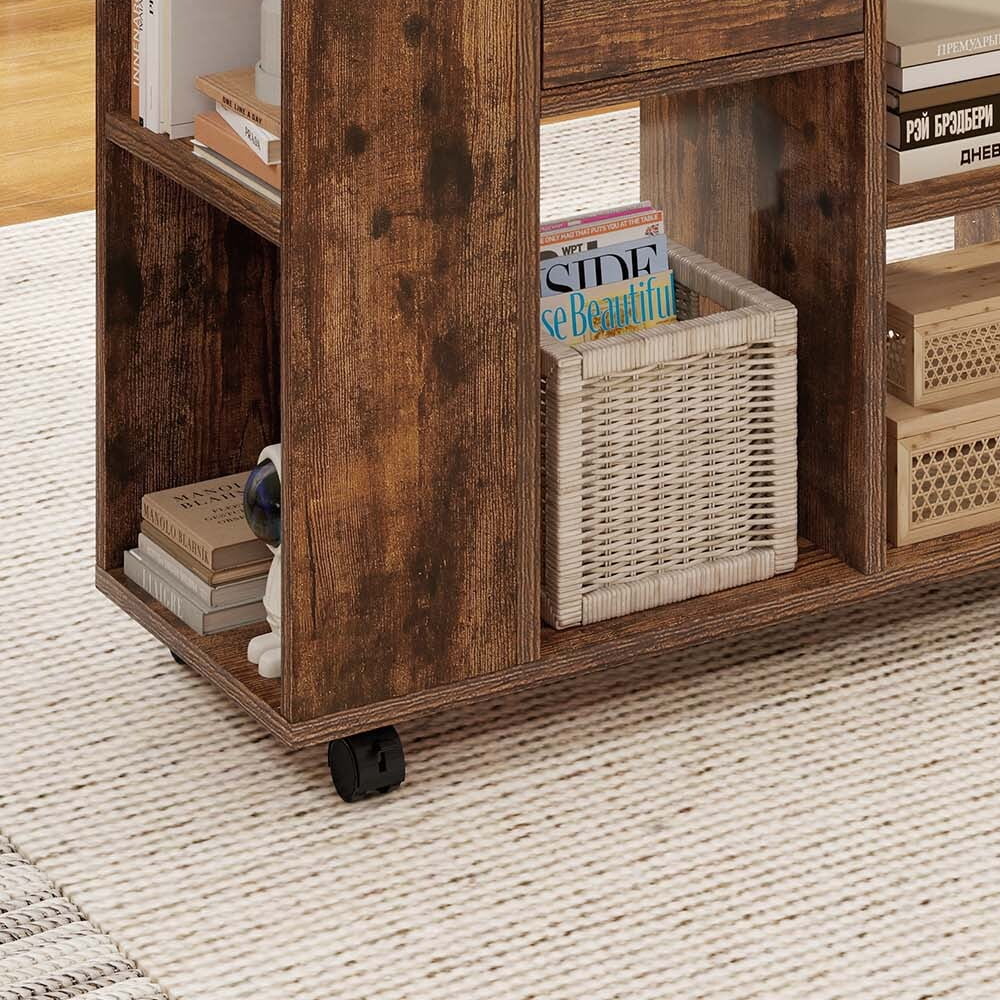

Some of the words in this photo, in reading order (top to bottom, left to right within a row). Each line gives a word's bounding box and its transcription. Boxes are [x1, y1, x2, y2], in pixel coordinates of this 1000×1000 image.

[222, 95, 232, 107] ONE
[251, 113, 262, 124] DAY
[906, 111, 930, 144] РЭЙ
[935, 103, 993, 138] БРЭДБЕРИ
[606, 223, 620, 231] YOU
[561, 243, 583, 256] WPT
[541, 244, 657, 293] SIDE
[541, 306, 567, 341] se
[570, 272, 676, 337] Beautiful
[173, 482, 241, 501] MANOL
[144, 503, 176, 538] MANOLO
[178, 529, 210, 565] BLAHNIK
